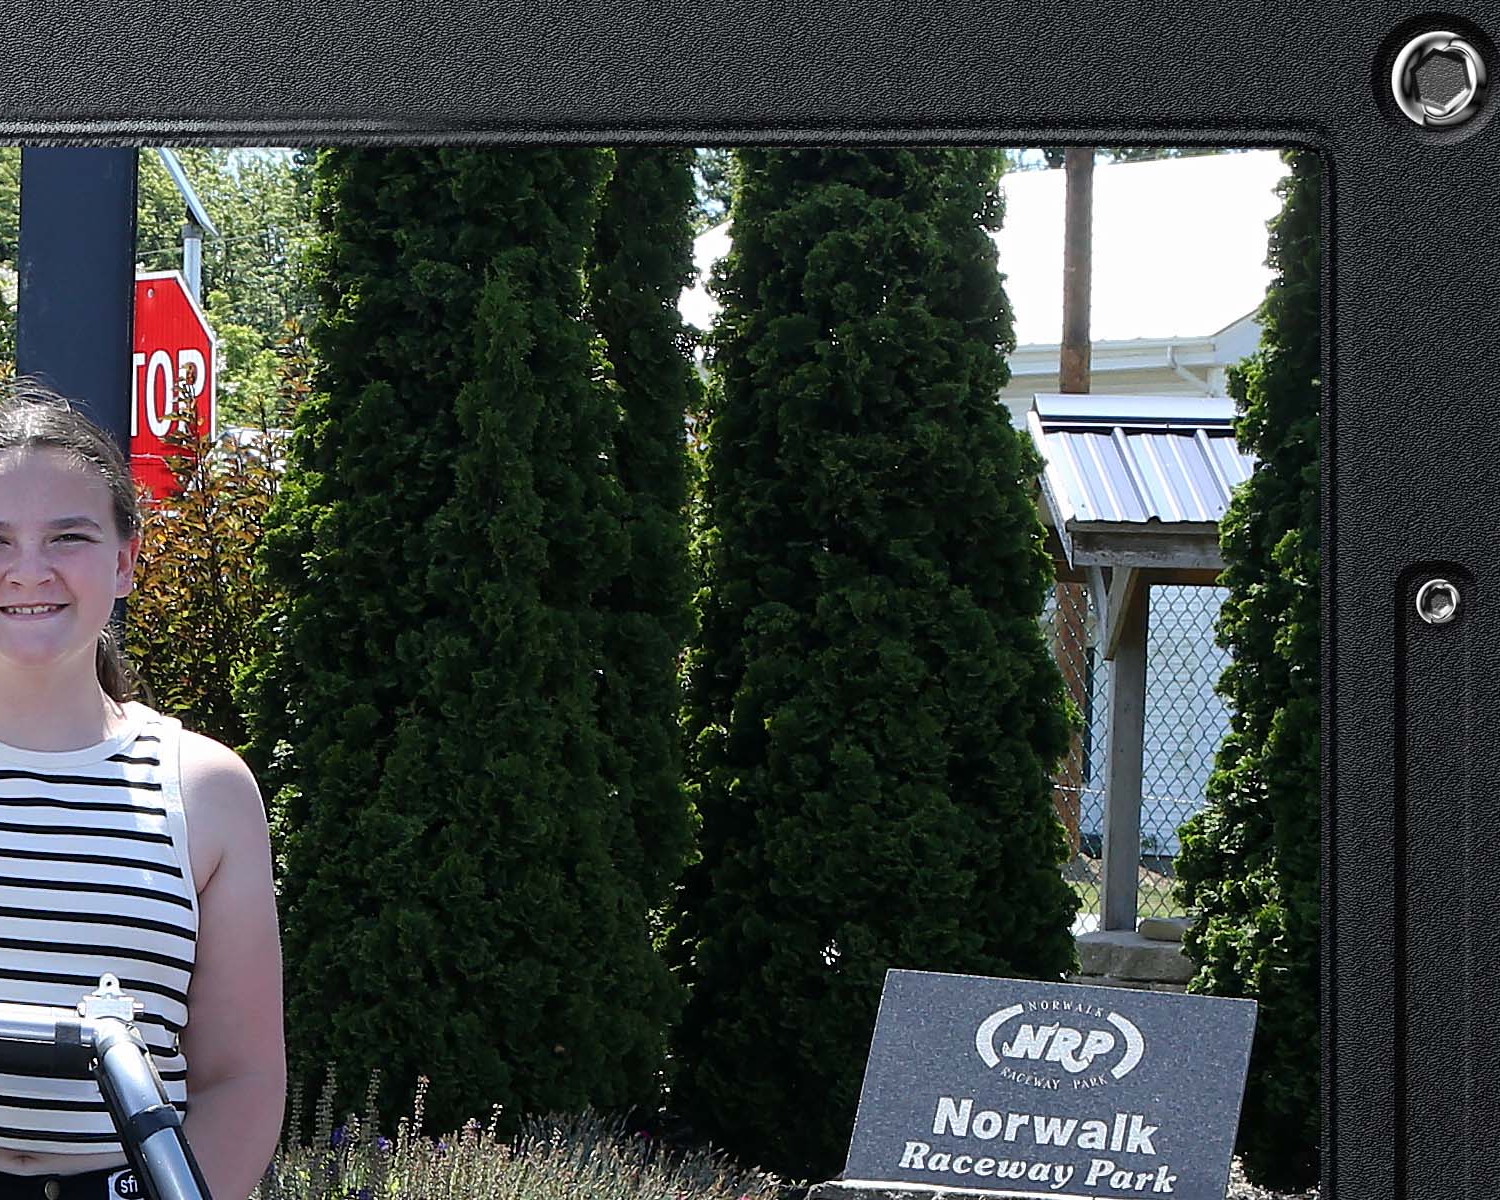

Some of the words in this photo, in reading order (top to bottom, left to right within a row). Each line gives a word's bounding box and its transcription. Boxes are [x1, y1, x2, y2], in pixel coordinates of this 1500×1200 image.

[130, 349, 206, 438] TOP
[1029, 1000, 1104, 1017] NORWALK
[1002, 1022, 1115, 1073] NRP
[1000, 1066, 1060, 1090] RACEWAY
[1073, 1074, 1108, 1090] PARK
[932, 1097, 1159, 1156] Norwalk
[899, 1141, 1074, 1190] Raceway
[1086, 1159, 1178, 1194] Park
